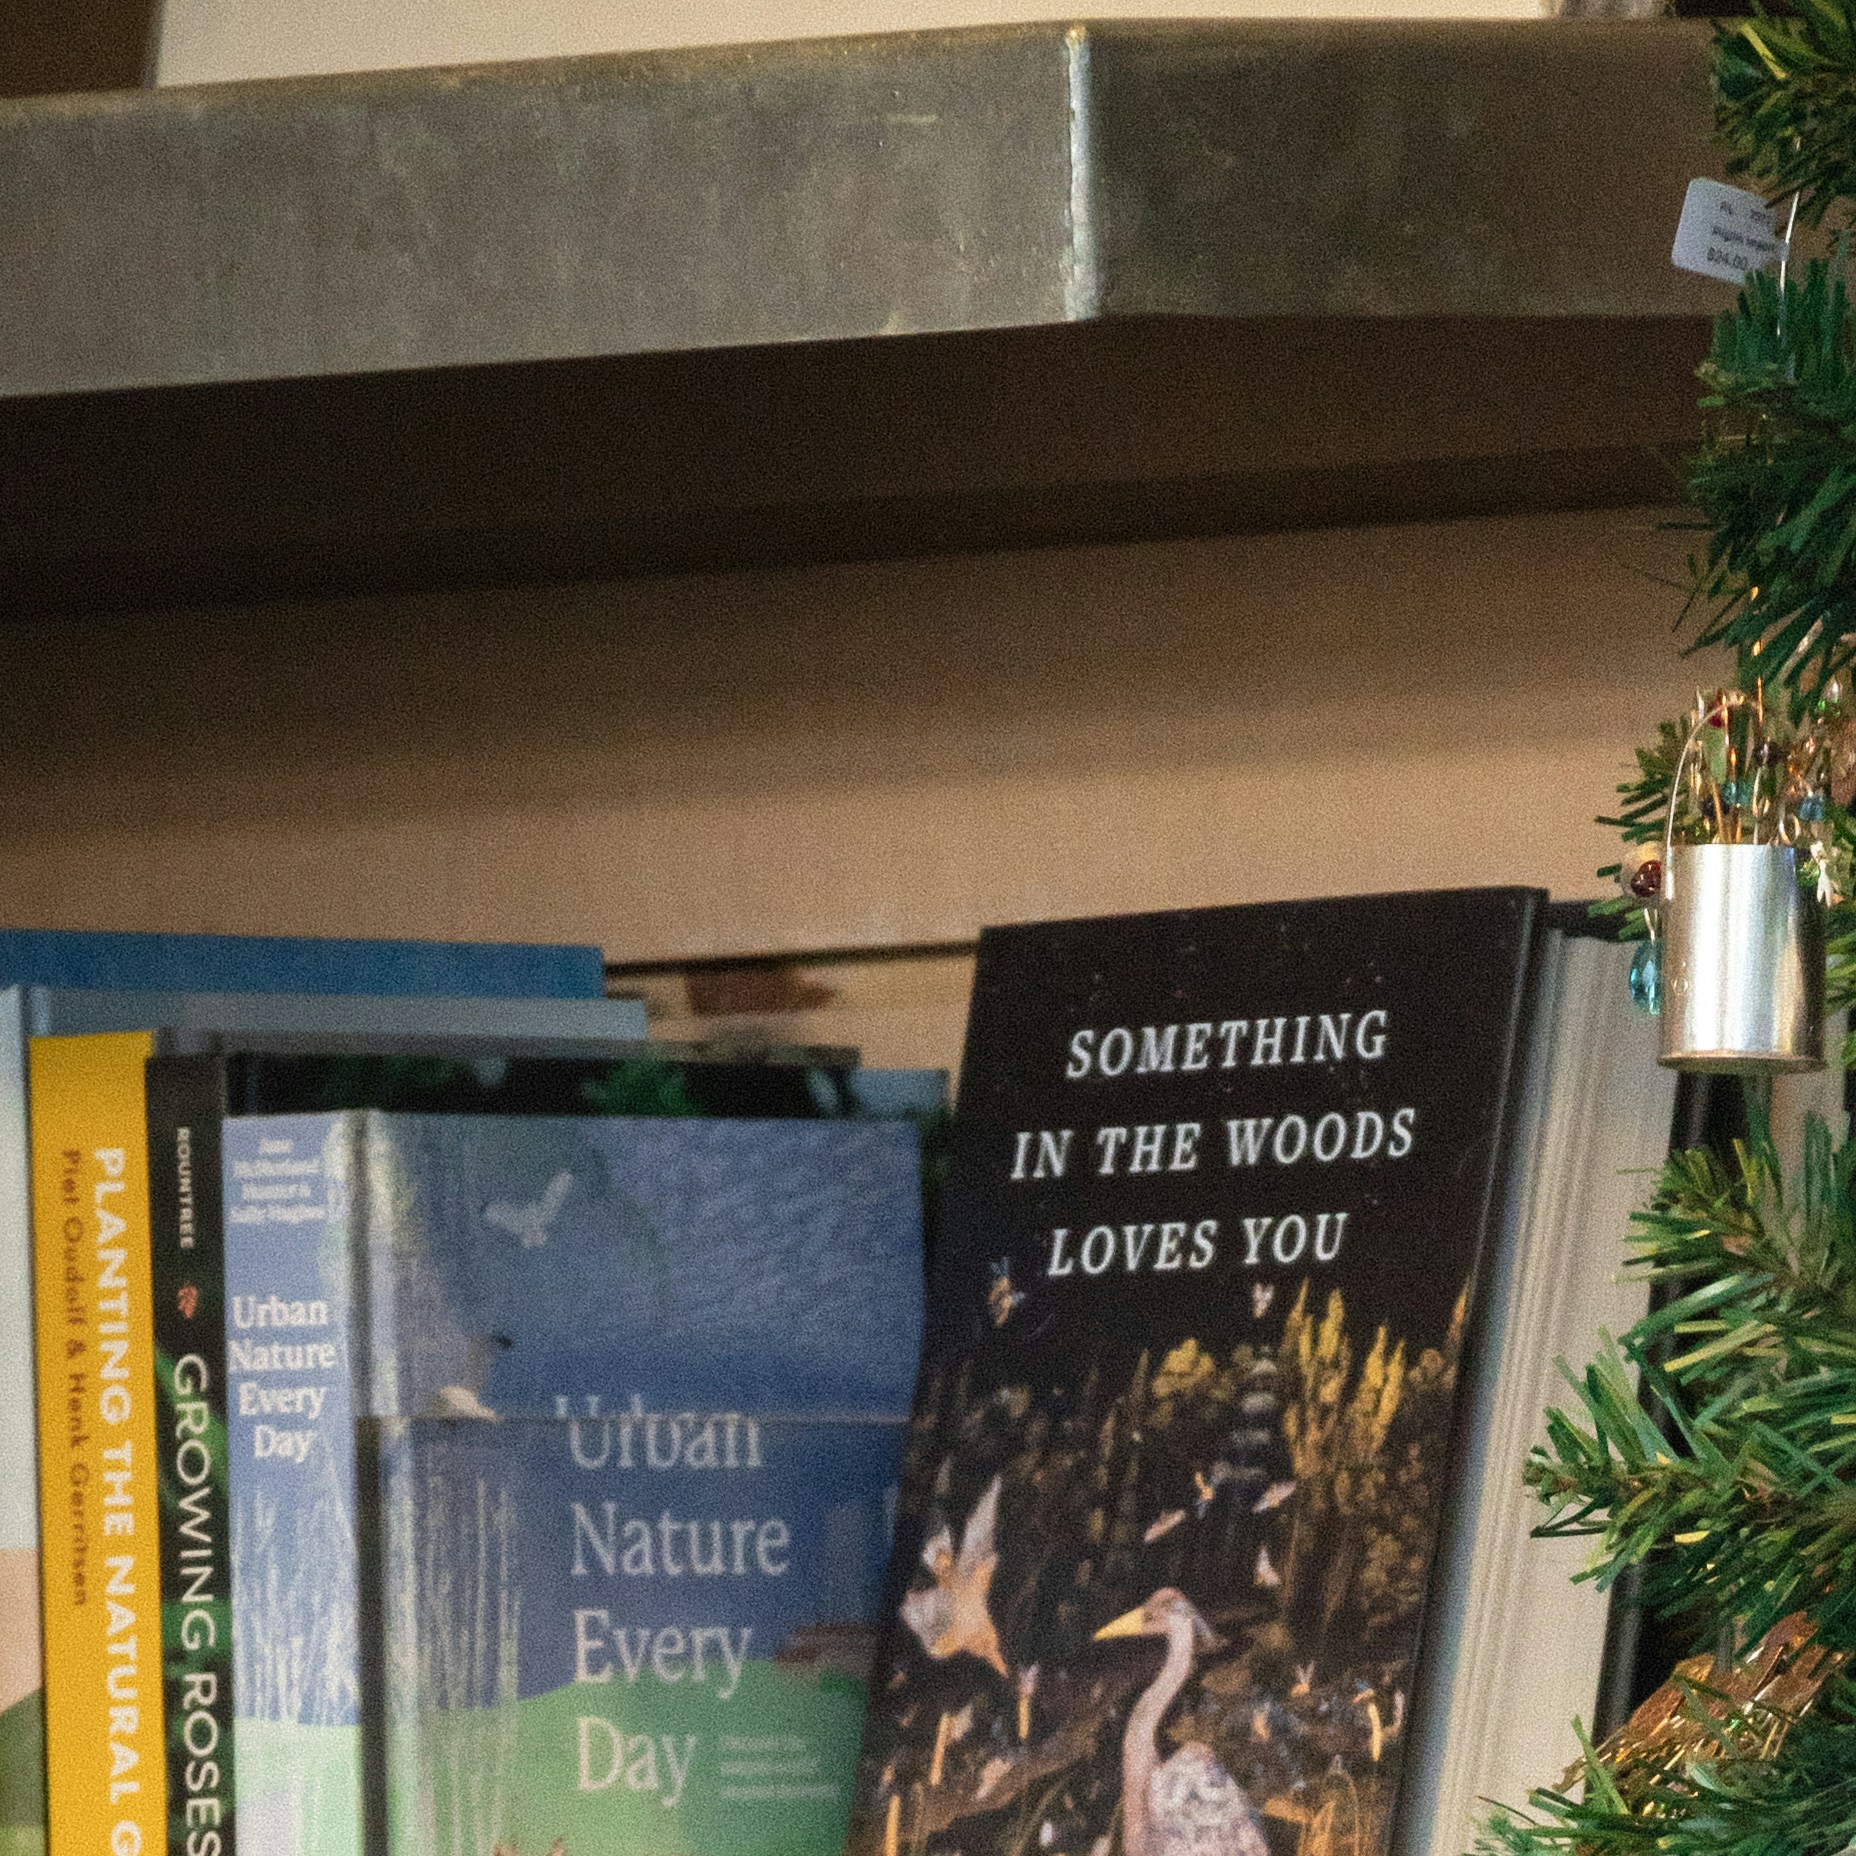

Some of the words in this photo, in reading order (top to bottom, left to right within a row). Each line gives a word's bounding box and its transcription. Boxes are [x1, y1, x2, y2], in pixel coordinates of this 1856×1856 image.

[1065, 1010, 1389, 1081] SOMETHING
[64, 1149, 81, 1200] Piet
[1010, 1130, 1074, 1180] IN
[1096, 1122, 1200, 1177] THE
[1226, 1107, 1416, 1168] WOODS
[177, 1126, 196, 1250] ROUNTREE
[64, 1214, 84, 1326] Oudolf
[1048, 1219, 1218, 1278] LOVES
[1243, 1212, 1350, 1266] YOU
[95, 1148, 133, 1425] PLANTING
[231, 1294, 329, 1330] Urban
[66, 1339, 83, 1362] &
[228, 1337, 338, 1374] Nature
[67, 1373, 87, 1449] Henk
[238, 1381, 328, 1422] Every
[558, 1394, 764, 1469] Urban
[253, 1423, 314, 1464] Day
[102, 1440, 133, 1535] THE
[173, 1354, 217, 1652] GROWING
[69, 1465, 91, 1607] Gerritsen
[571, 1502, 791, 1576] Nature
[103, 1556, 140, 1804] NATURAL
[575, 1609, 753, 1699] Every
[577, 1716, 698, 1807] Day
